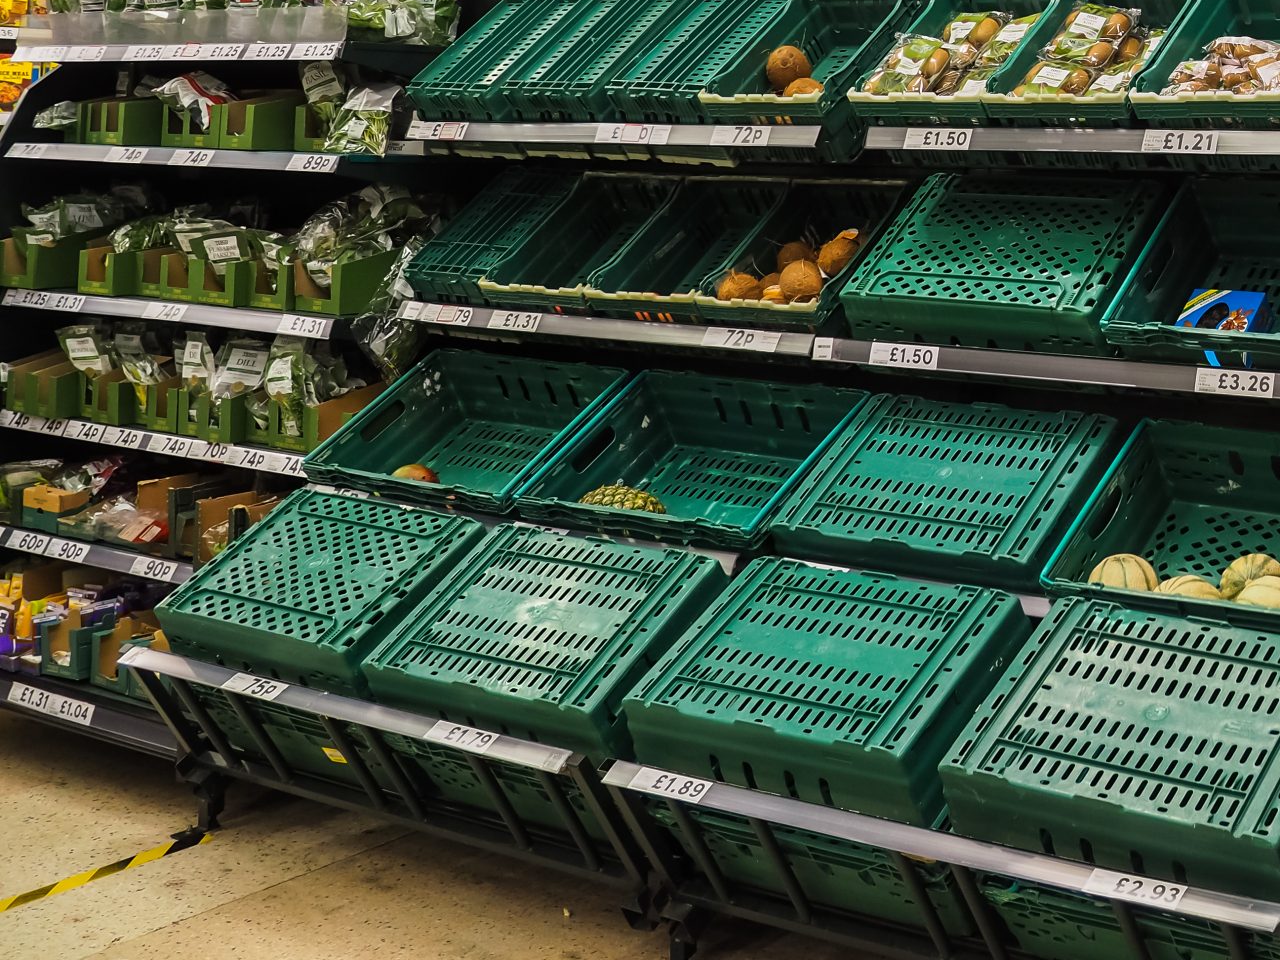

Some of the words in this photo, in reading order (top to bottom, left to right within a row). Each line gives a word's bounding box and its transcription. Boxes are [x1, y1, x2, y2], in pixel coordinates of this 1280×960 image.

[134, 47, 161, 58] £1.25
[211, 46, 239, 58] £1.25
[256, 46, 287, 58] £1.25
[303, 44, 334, 57] £1.25
[731, 126, 763, 144] 72p
[922, 131, 968, 147] £1.50
[1162, 132, 1214, 152] £1.21
[118, 148, 142, 161] 74p
[183, 151, 208, 164] 74p
[302, 155, 331, 171] 89p
[22, 291, 48, 306] £1.25
[55, 296, 83, 311] £1.31
[155, 304, 181, 320] 74p
[502, 312, 539, 329] £1.31
[290, 318, 323, 335] £1.31
[723, 329, 755, 348] 72p
[236, 358, 257, 368] DILL
[889, 346, 934, 365] £1.50
[1217, 372, 1271, 393] £3.26
[8, 412, 30, 428] 74p
[40, 418, 62, 433] 74p
[76, 423, 99, 439] 74p
[114, 429, 138, 446] 74p
[161, 437, 186, 454] 74p
[203, 442, 228, 459] 70p
[240, 450, 265, 467] 74p
[18, 533, 44, 551] 60p
[57, 542, 83, 560] 90p
[143, 560, 171, 579] 90p
[241, 677, 277, 697] 75p
[20, 687, 50, 708] £1.31
[59, 700, 89, 721] £1.04
[443, 725, 493, 748] £1.79
[651, 774, 706, 798] £1.89
[1113, 876, 1181, 903] £2.93
